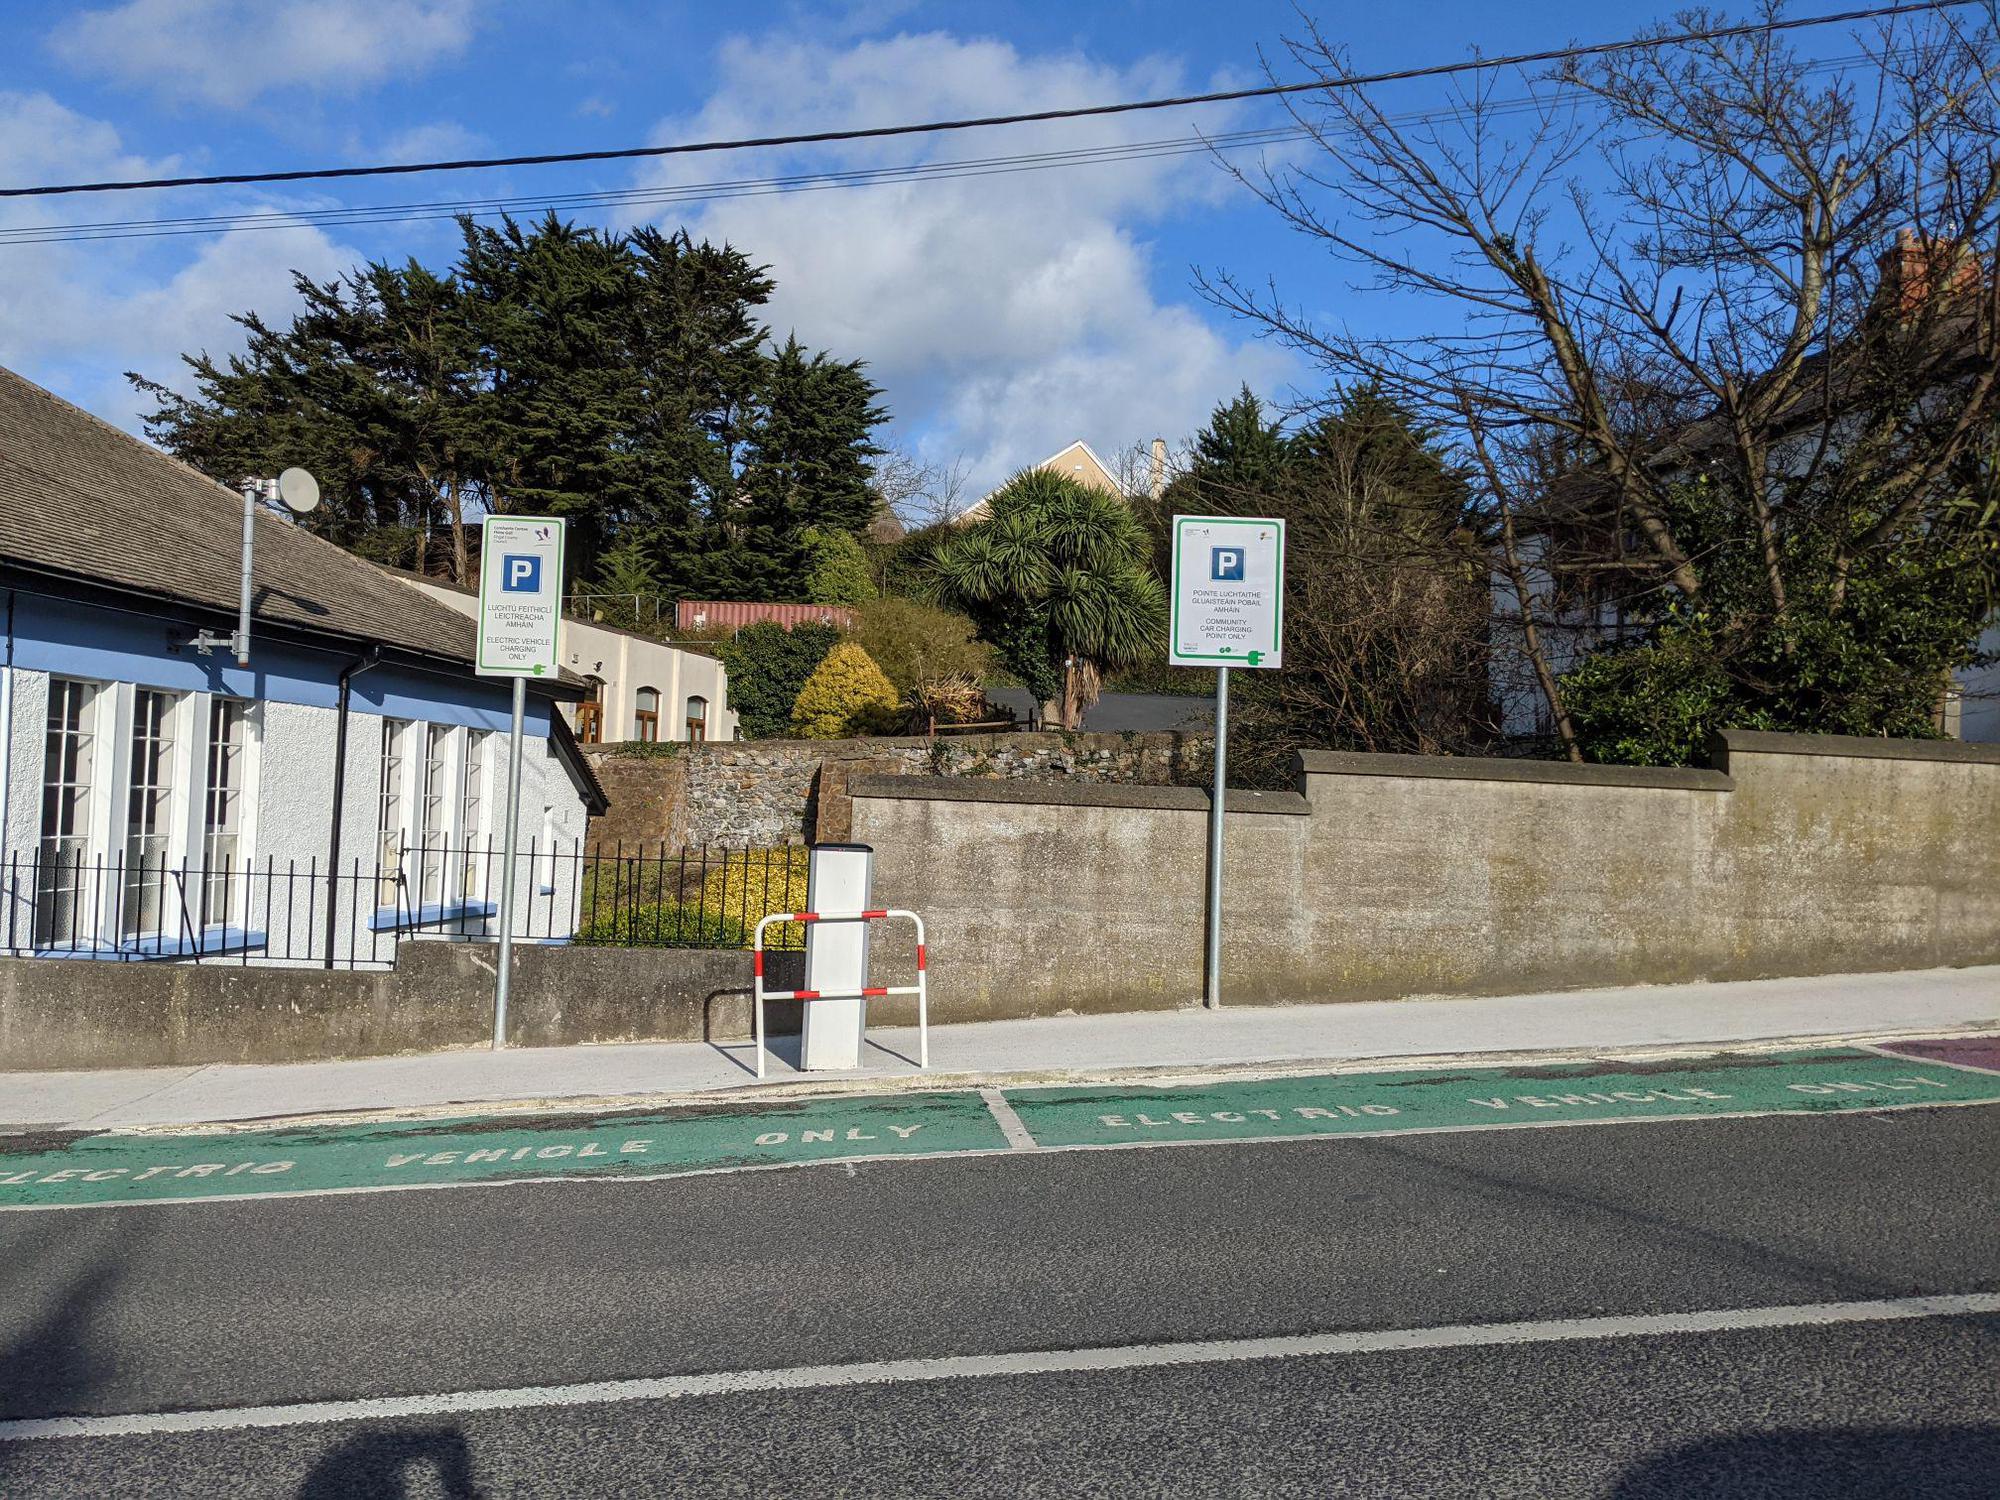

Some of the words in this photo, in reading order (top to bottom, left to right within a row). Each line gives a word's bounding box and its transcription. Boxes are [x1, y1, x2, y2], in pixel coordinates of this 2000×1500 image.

[1219, 552, 1236, 576] P
[511, 560, 532, 587] P
[1192, 589, 1219, 597] POINTE
[1219, 590, 1262, 598] LUCHTAITHE
[1237, 598, 1263, 606] POBAIL
[494, 612, 545, 621] LEICTREACHA
[521, 638, 551, 646] VEHICLE
[499, 645, 537, 653] CHARGING
[1098, 1103, 1401, 1127] ELECTRIC
[1467, 1086, 1732, 1109] VEHICLE
[1787, 1075, 1949, 1095] ONLY
[383, 1138, 654, 1168] VEHICLE
[754, 1123, 923, 1146] ONLY
